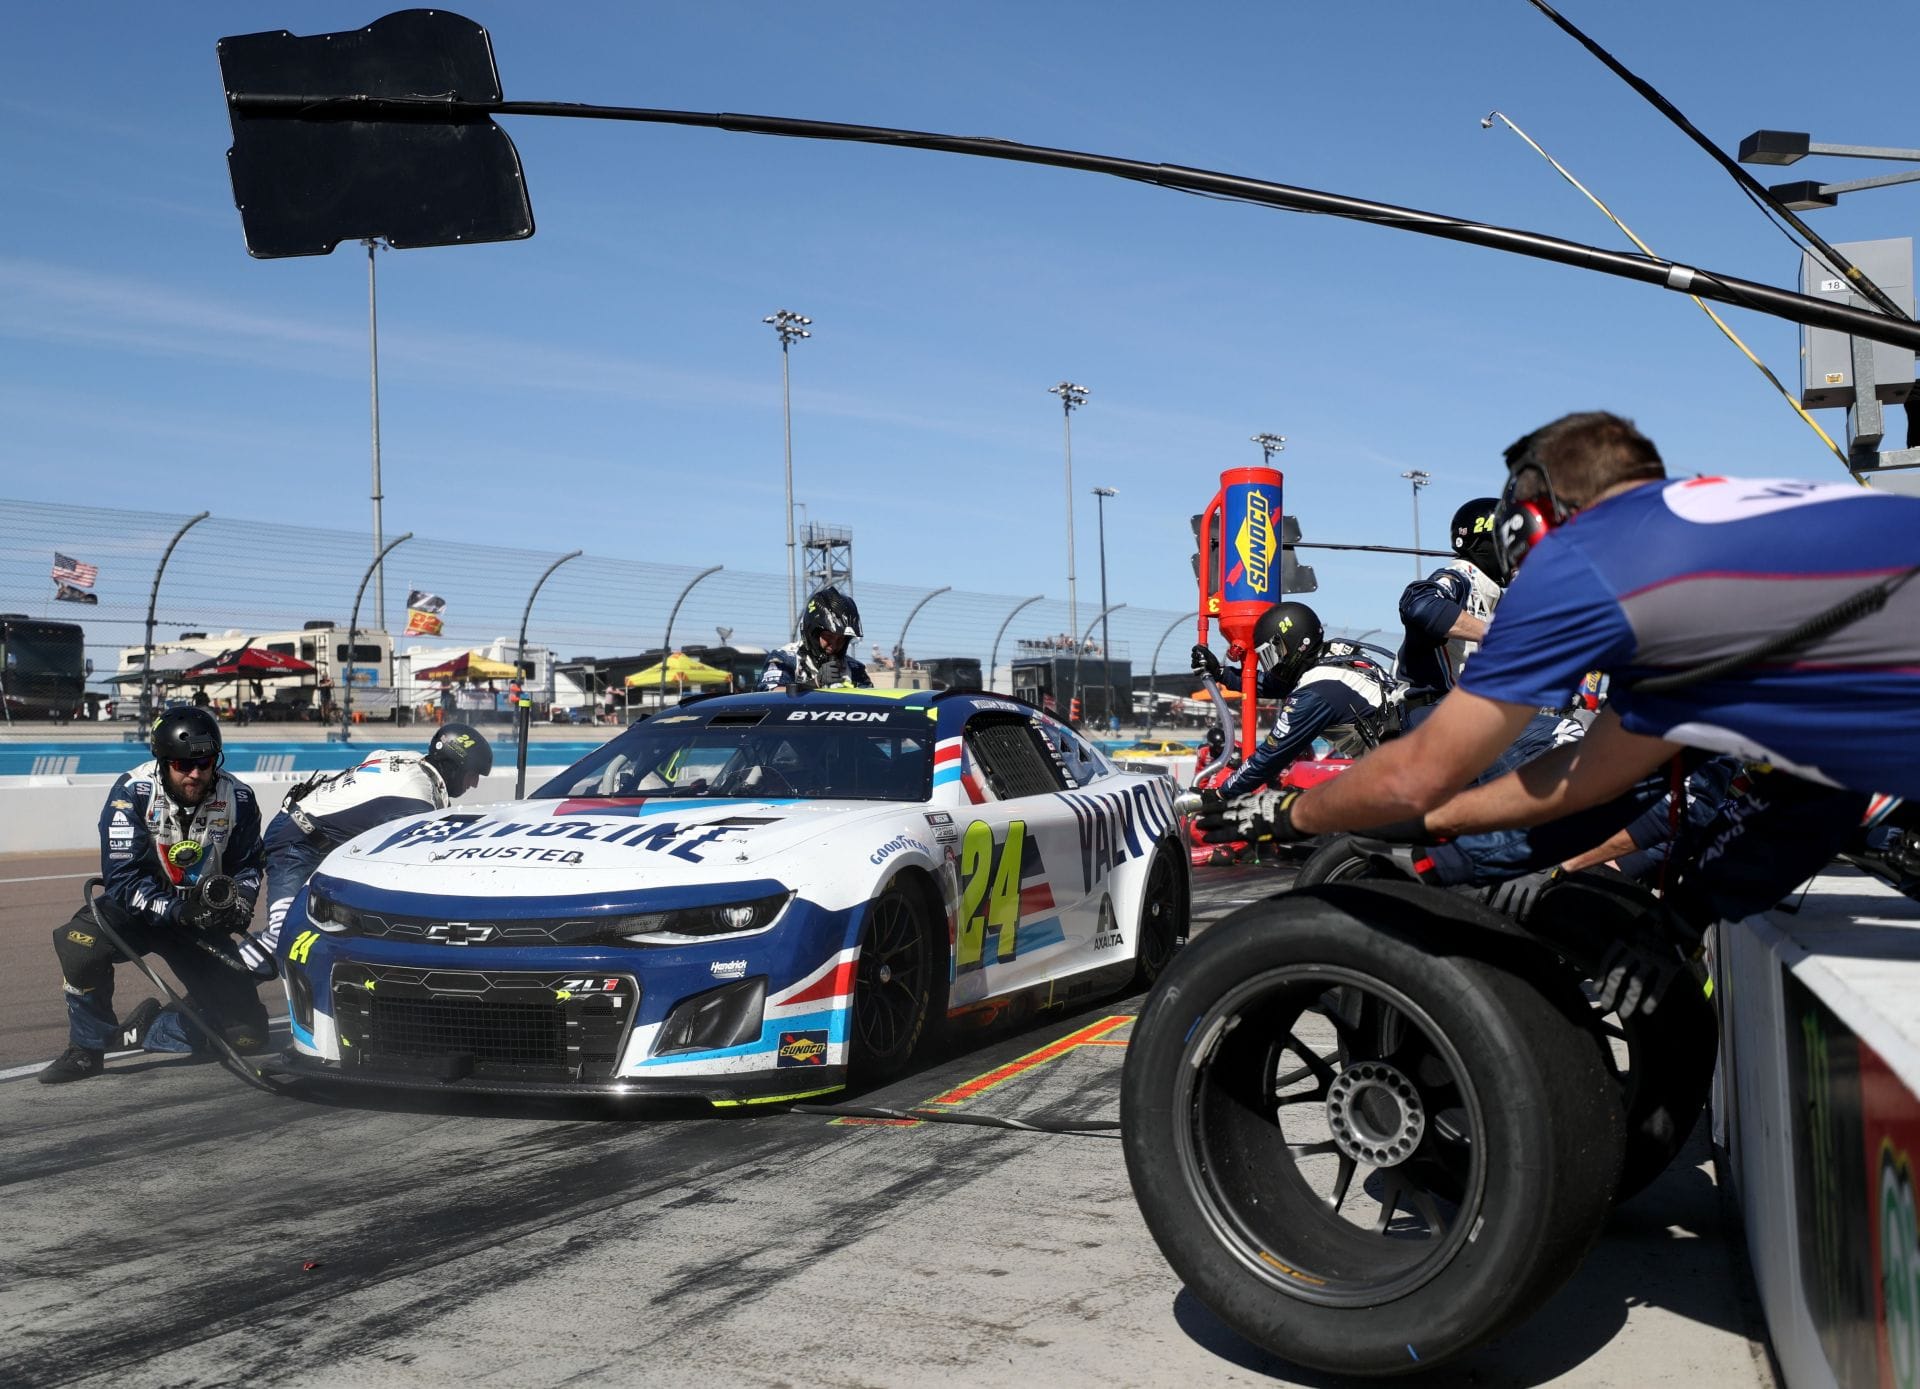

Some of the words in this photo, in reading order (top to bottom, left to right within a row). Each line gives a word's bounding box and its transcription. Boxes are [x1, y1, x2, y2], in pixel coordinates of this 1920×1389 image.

[1828, 281, 1840, 289] 18
[1473, 513, 1495, 533] 24
[1249, 498, 1267, 589] SUNOCO
[1278, 616, 1294, 633] 24
[786, 710, 890, 723] BYRON
[456, 734, 476, 748] 24
[443, 846, 584, 863] TRUSTED
[869, 834, 931, 865] GOODYEAR
[956, 820, 1027, 966] 24
[288, 930, 320, 965] 24
[1094, 933, 1124, 951] AXALTA
[710, 959, 748, 973] Hendrick
[781, 1043, 825, 1055] SUNOCO
